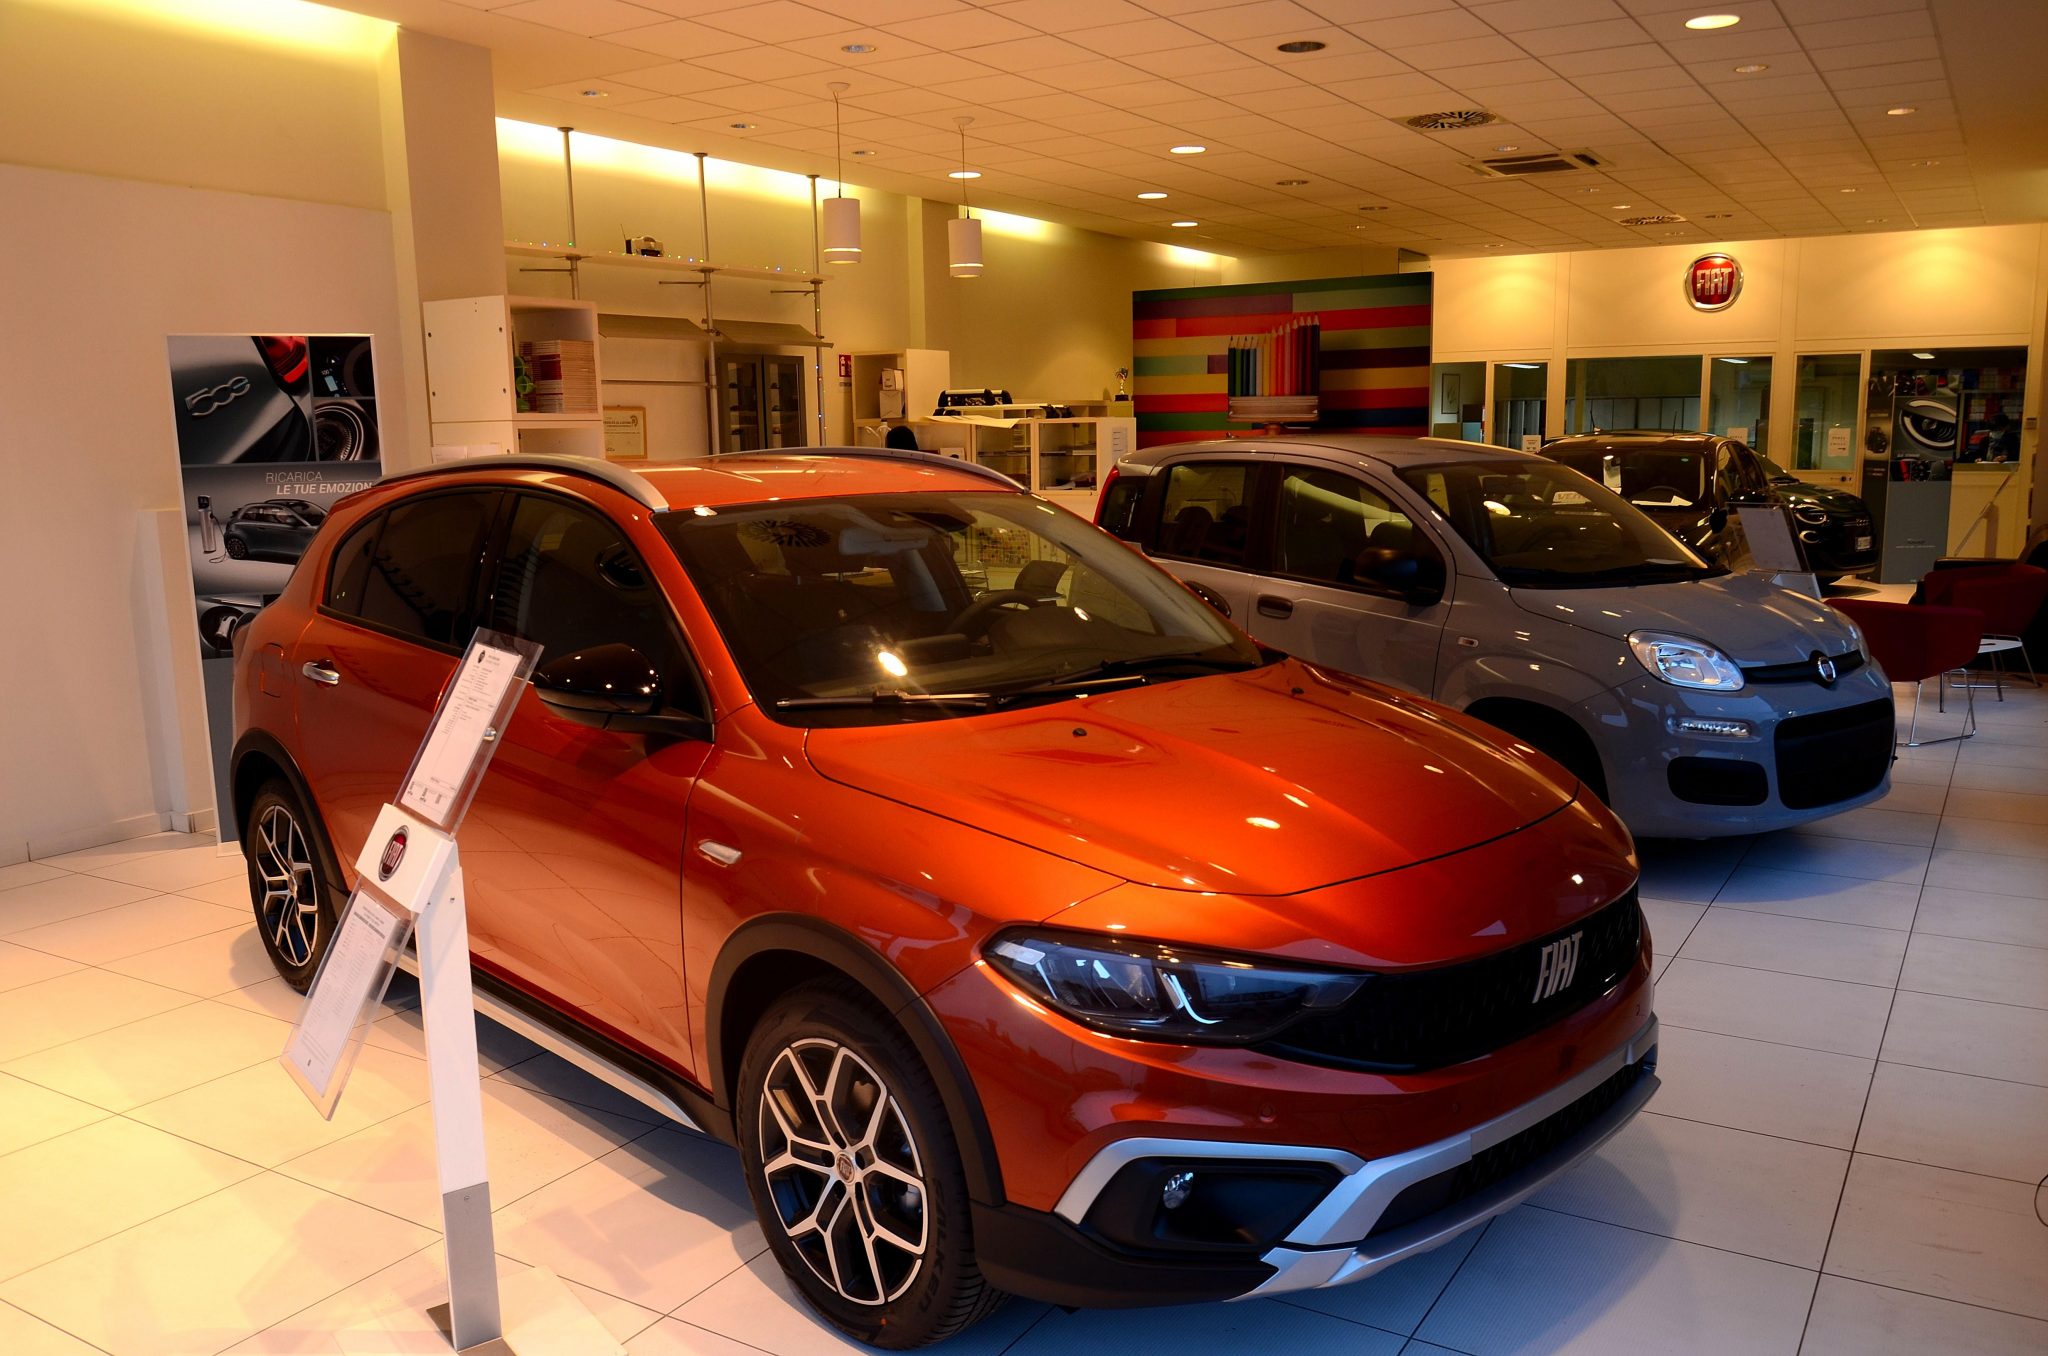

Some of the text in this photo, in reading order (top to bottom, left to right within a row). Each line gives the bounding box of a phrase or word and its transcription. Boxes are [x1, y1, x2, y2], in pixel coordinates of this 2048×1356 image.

[1696, 268, 1732, 296] FIAT
[185, 376, 251, 416] 500
[266, 471, 323, 483] RICARICA
[276, 485, 290, 495] LE
[293, 484, 317, 495] TUE
[384, 840, 404, 867] FIAT
[1532, 930, 1583, 1004] FIAT
[919, 1178, 947, 1313] FALKEN
